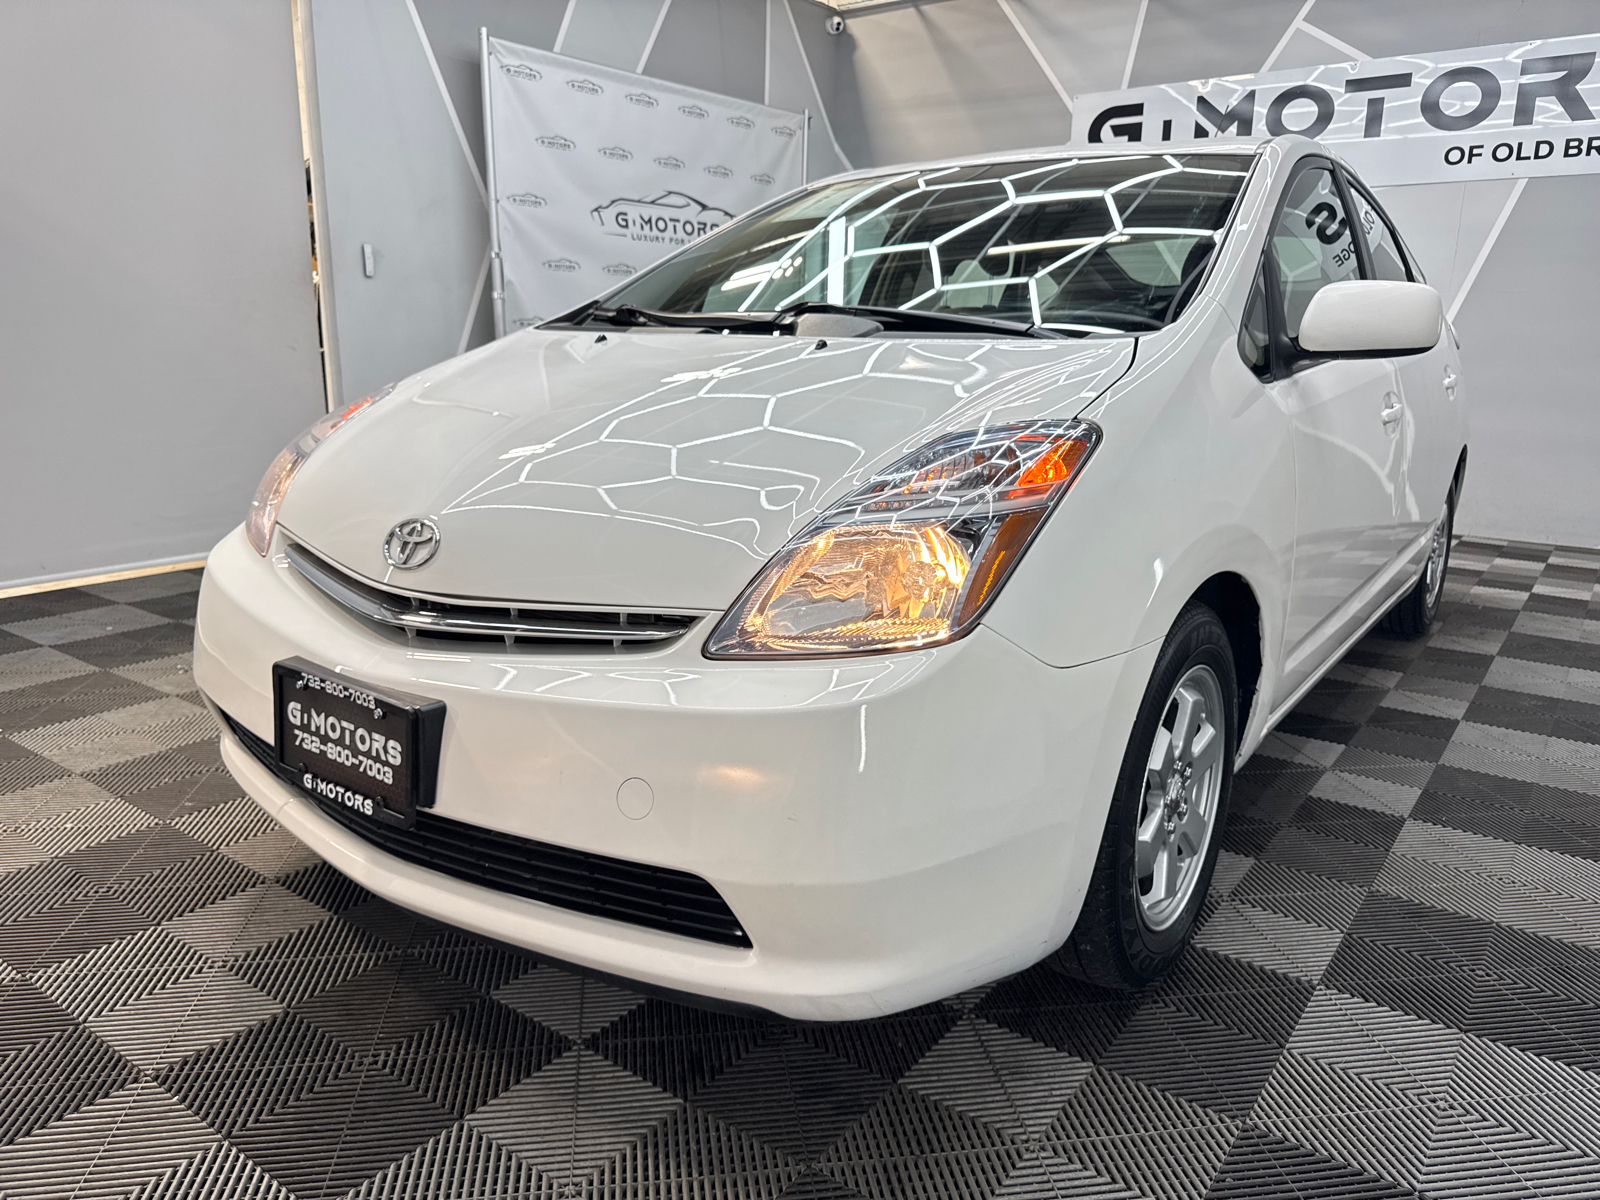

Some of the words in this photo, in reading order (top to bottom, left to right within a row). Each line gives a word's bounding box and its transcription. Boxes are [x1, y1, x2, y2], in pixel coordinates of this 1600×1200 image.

[1444, 145, 1485, 166] OF
[1491, 140, 1555, 163] OLD
[631, 233, 666, 244] LUXURY
[669, 237, 686, 246] FOR
[301, 672, 376, 710] 732-800-7003
[310, 707, 402, 767] MOTORS
[293, 728, 394, 786] 732-800-7003
